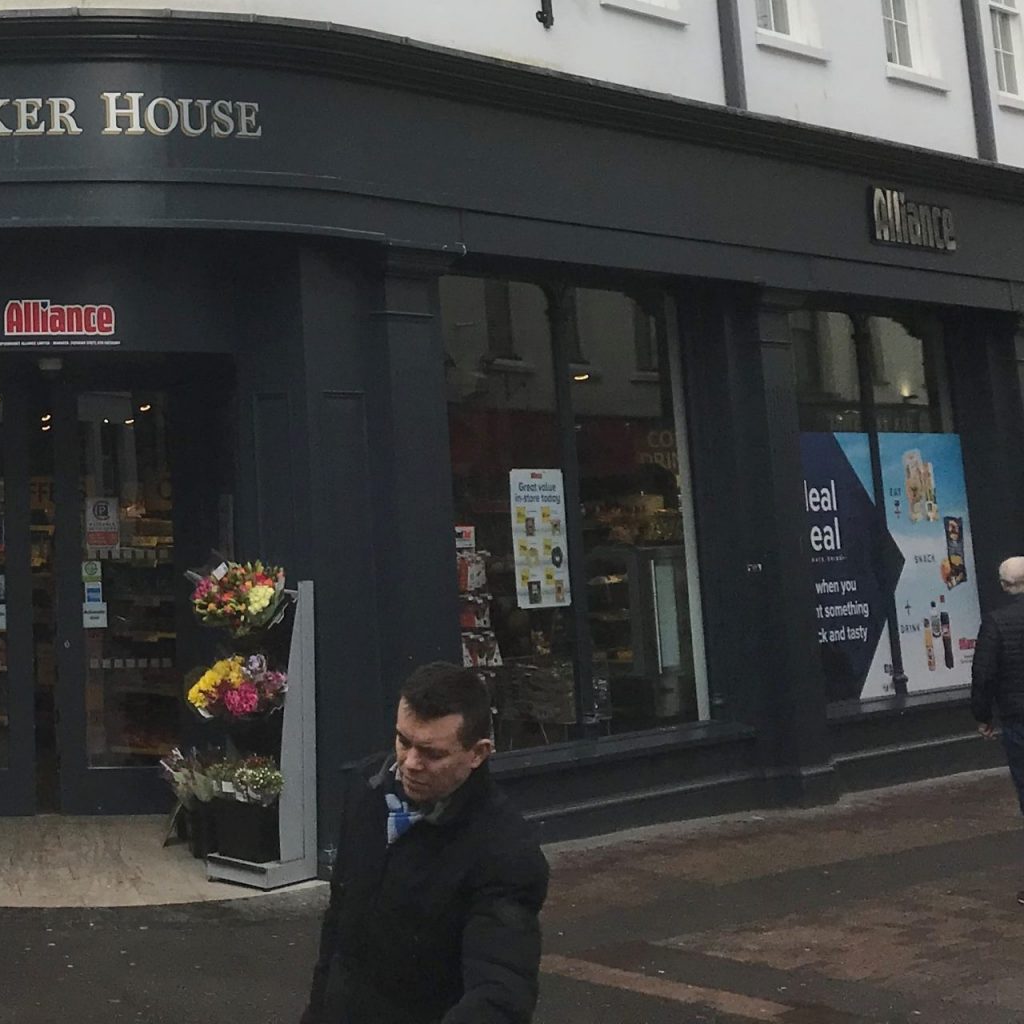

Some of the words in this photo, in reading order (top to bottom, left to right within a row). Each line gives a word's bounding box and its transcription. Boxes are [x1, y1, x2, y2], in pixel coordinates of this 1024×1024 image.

[100, 91, 263, 139] HOUSE
[873, 187, 957, 251] Alliance
[4, 299, 115, 336] Alliance
[518, 482, 538, 492] Great
[538, 483, 557, 492] value
[514, 493, 540, 504] in-store
[541, 494, 561, 505] today
[810, 516, 842, 552] eal
[815, 578, 839, 594] when
[840, 578, 857, 595] you
[824, 600, 870, 618] something
[829, 627, 846, 642] and
[847, 625, 869, 642] tasty
